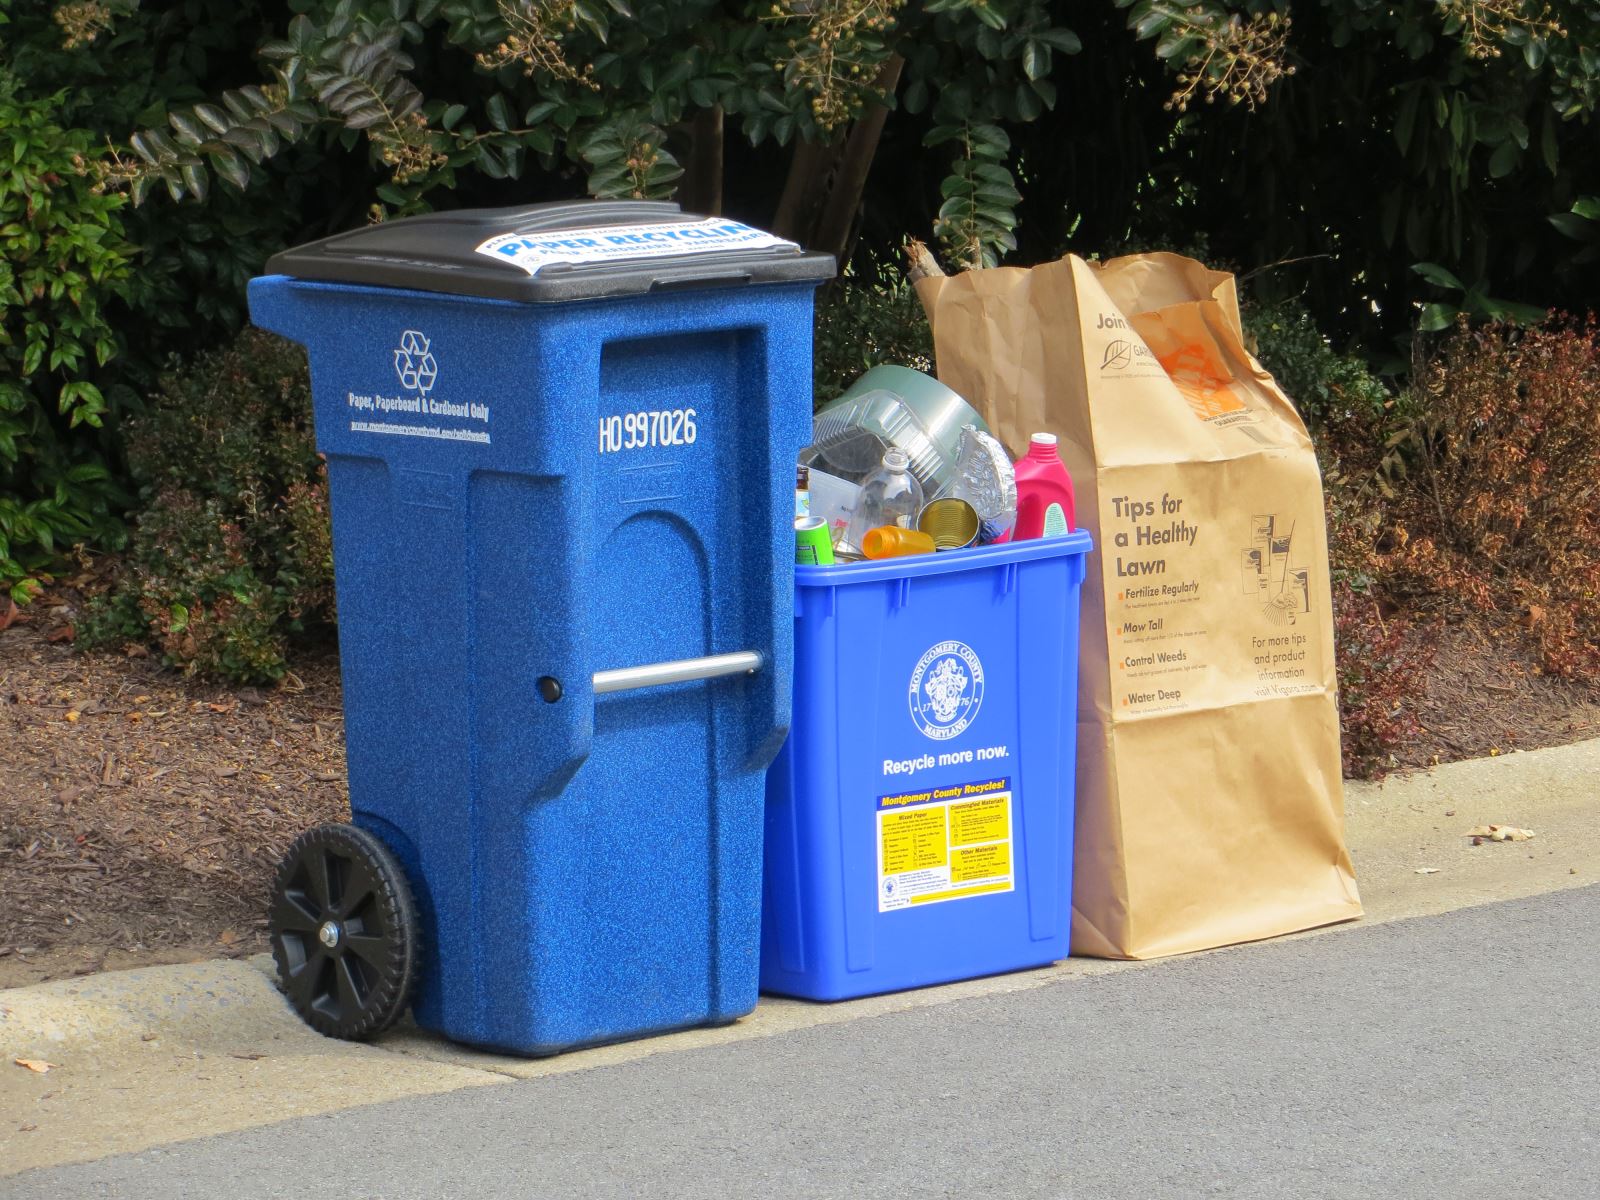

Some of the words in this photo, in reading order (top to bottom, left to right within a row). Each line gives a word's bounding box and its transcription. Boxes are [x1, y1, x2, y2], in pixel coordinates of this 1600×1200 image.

[497, 237, 602, 257] PAPER
[603, 223, 755, 246] RECYCLIN
[1097, 313, 1126, 329] Join
[349, 392, 374, 411] Paper,
[375, 394, 420, 413] Paperboard
[430, 398, 469, 418] Cardboard
[470, 402, 489, 422] Only
[1112, 495, 1155, 522] Tips
[1162, 493, 1183, 514] for
[1115, 532, 1128, 547] a
[1136, 520, 1198, 546] Healthy
[1116, 557, 1166, 577] Lawn
[1125, 585, 1160, 600] Fertilize
[1161, 580, 1199, 597] Regularly
[1123, 622, 1146, 634] Mow
[1148, 618, 1163, 631] Tall
[1252, 637, 1266, 648] For
[1268, 636, 1289, 647] more
[1291, 632, 1307, 646] tips
[1125, 652, 1156, 667] Control
[1157, 649, 1187, 663] Weeds
[1254, 651, 1270, 665] and
[1273, 649, 1306, 666] product
[911, 642, 960, 693] MONTGOMERY
[960, 647, 983, 684] COUNTY
[1257, 666, 1305, 681] information
[1128, 692, 1155, 705] Water
[1157, 689, 1182, 702] Deep
[1254, 686, 1271, 697] visit
[923, 718, 967, 738] MARYLAND
[883, 753, 936, 775] Recycle
[938, 751, 973, 766] more
[976, 745, 1010, 761] now.
[881, 791, 931, 807] Montgomery
[933, 786, 963, 800] County
[964, 780, 1006, 794] Recycles!
[981, 798, 1005, 806] Materials
[899, 813, 913, 821] Mixed
[914, 811, 928, 819] Paper
[961, 848, 974, 856] Other
[975, 845, 998, 854] Materials
